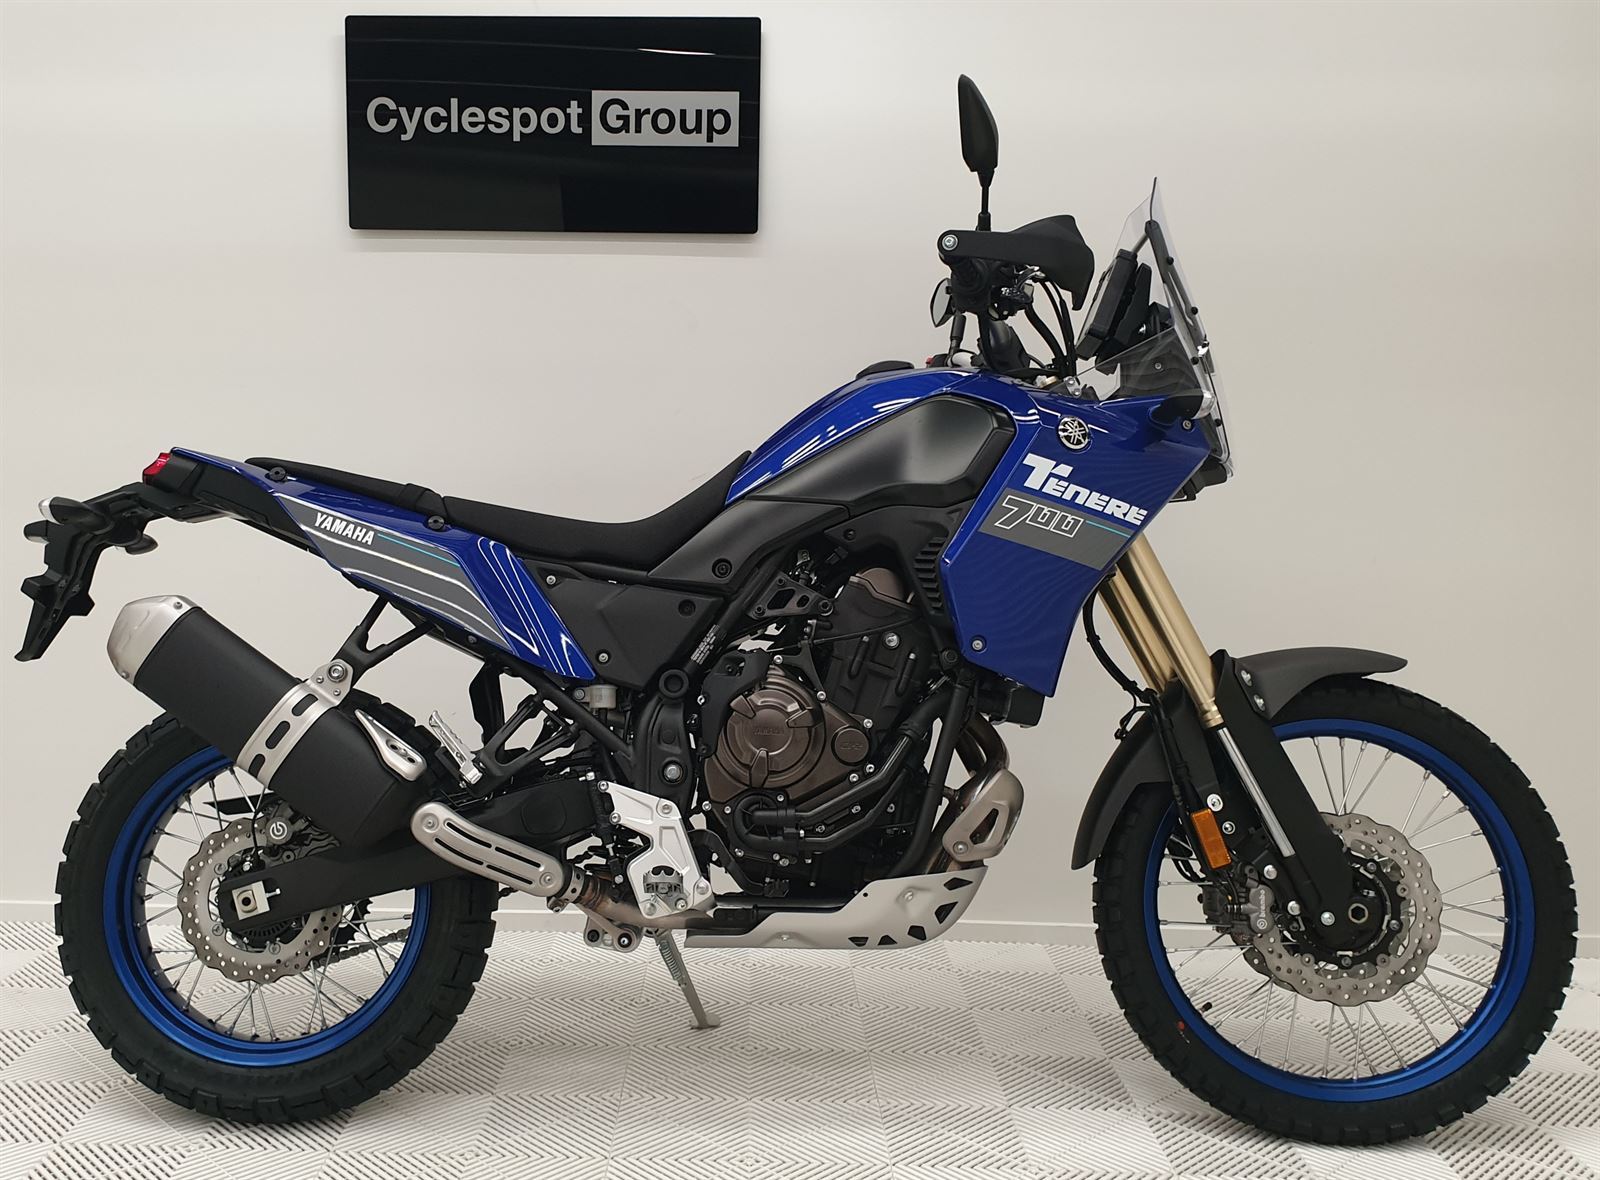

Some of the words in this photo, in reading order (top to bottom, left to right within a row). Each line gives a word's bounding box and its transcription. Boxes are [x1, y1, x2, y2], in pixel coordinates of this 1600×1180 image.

[366, 96, 583, 141] Cyclespot
[599, 98, 732, 143] Group
[314, 512, 375, 545] YAMAHA
[994, 494, 1084, 538] 700
